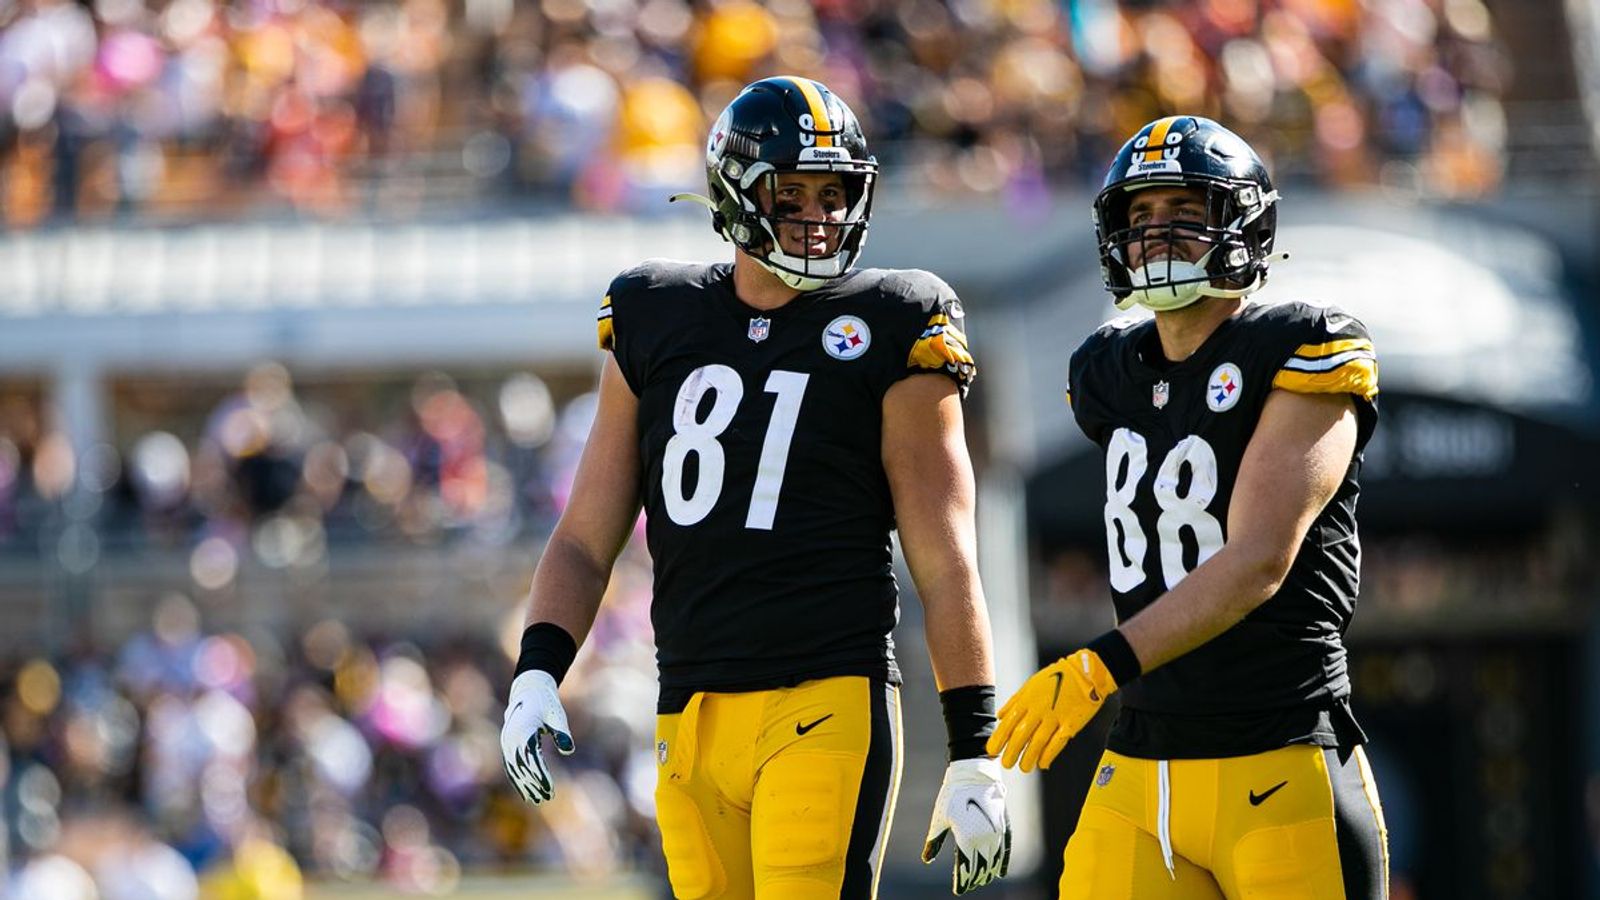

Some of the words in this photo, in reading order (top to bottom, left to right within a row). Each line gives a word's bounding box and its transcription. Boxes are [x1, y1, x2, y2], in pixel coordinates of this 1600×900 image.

[813, 149, 841, 159] Steelers
[661, 364, 811, 531] 81
[1104, 427, 1225, 593] 88
